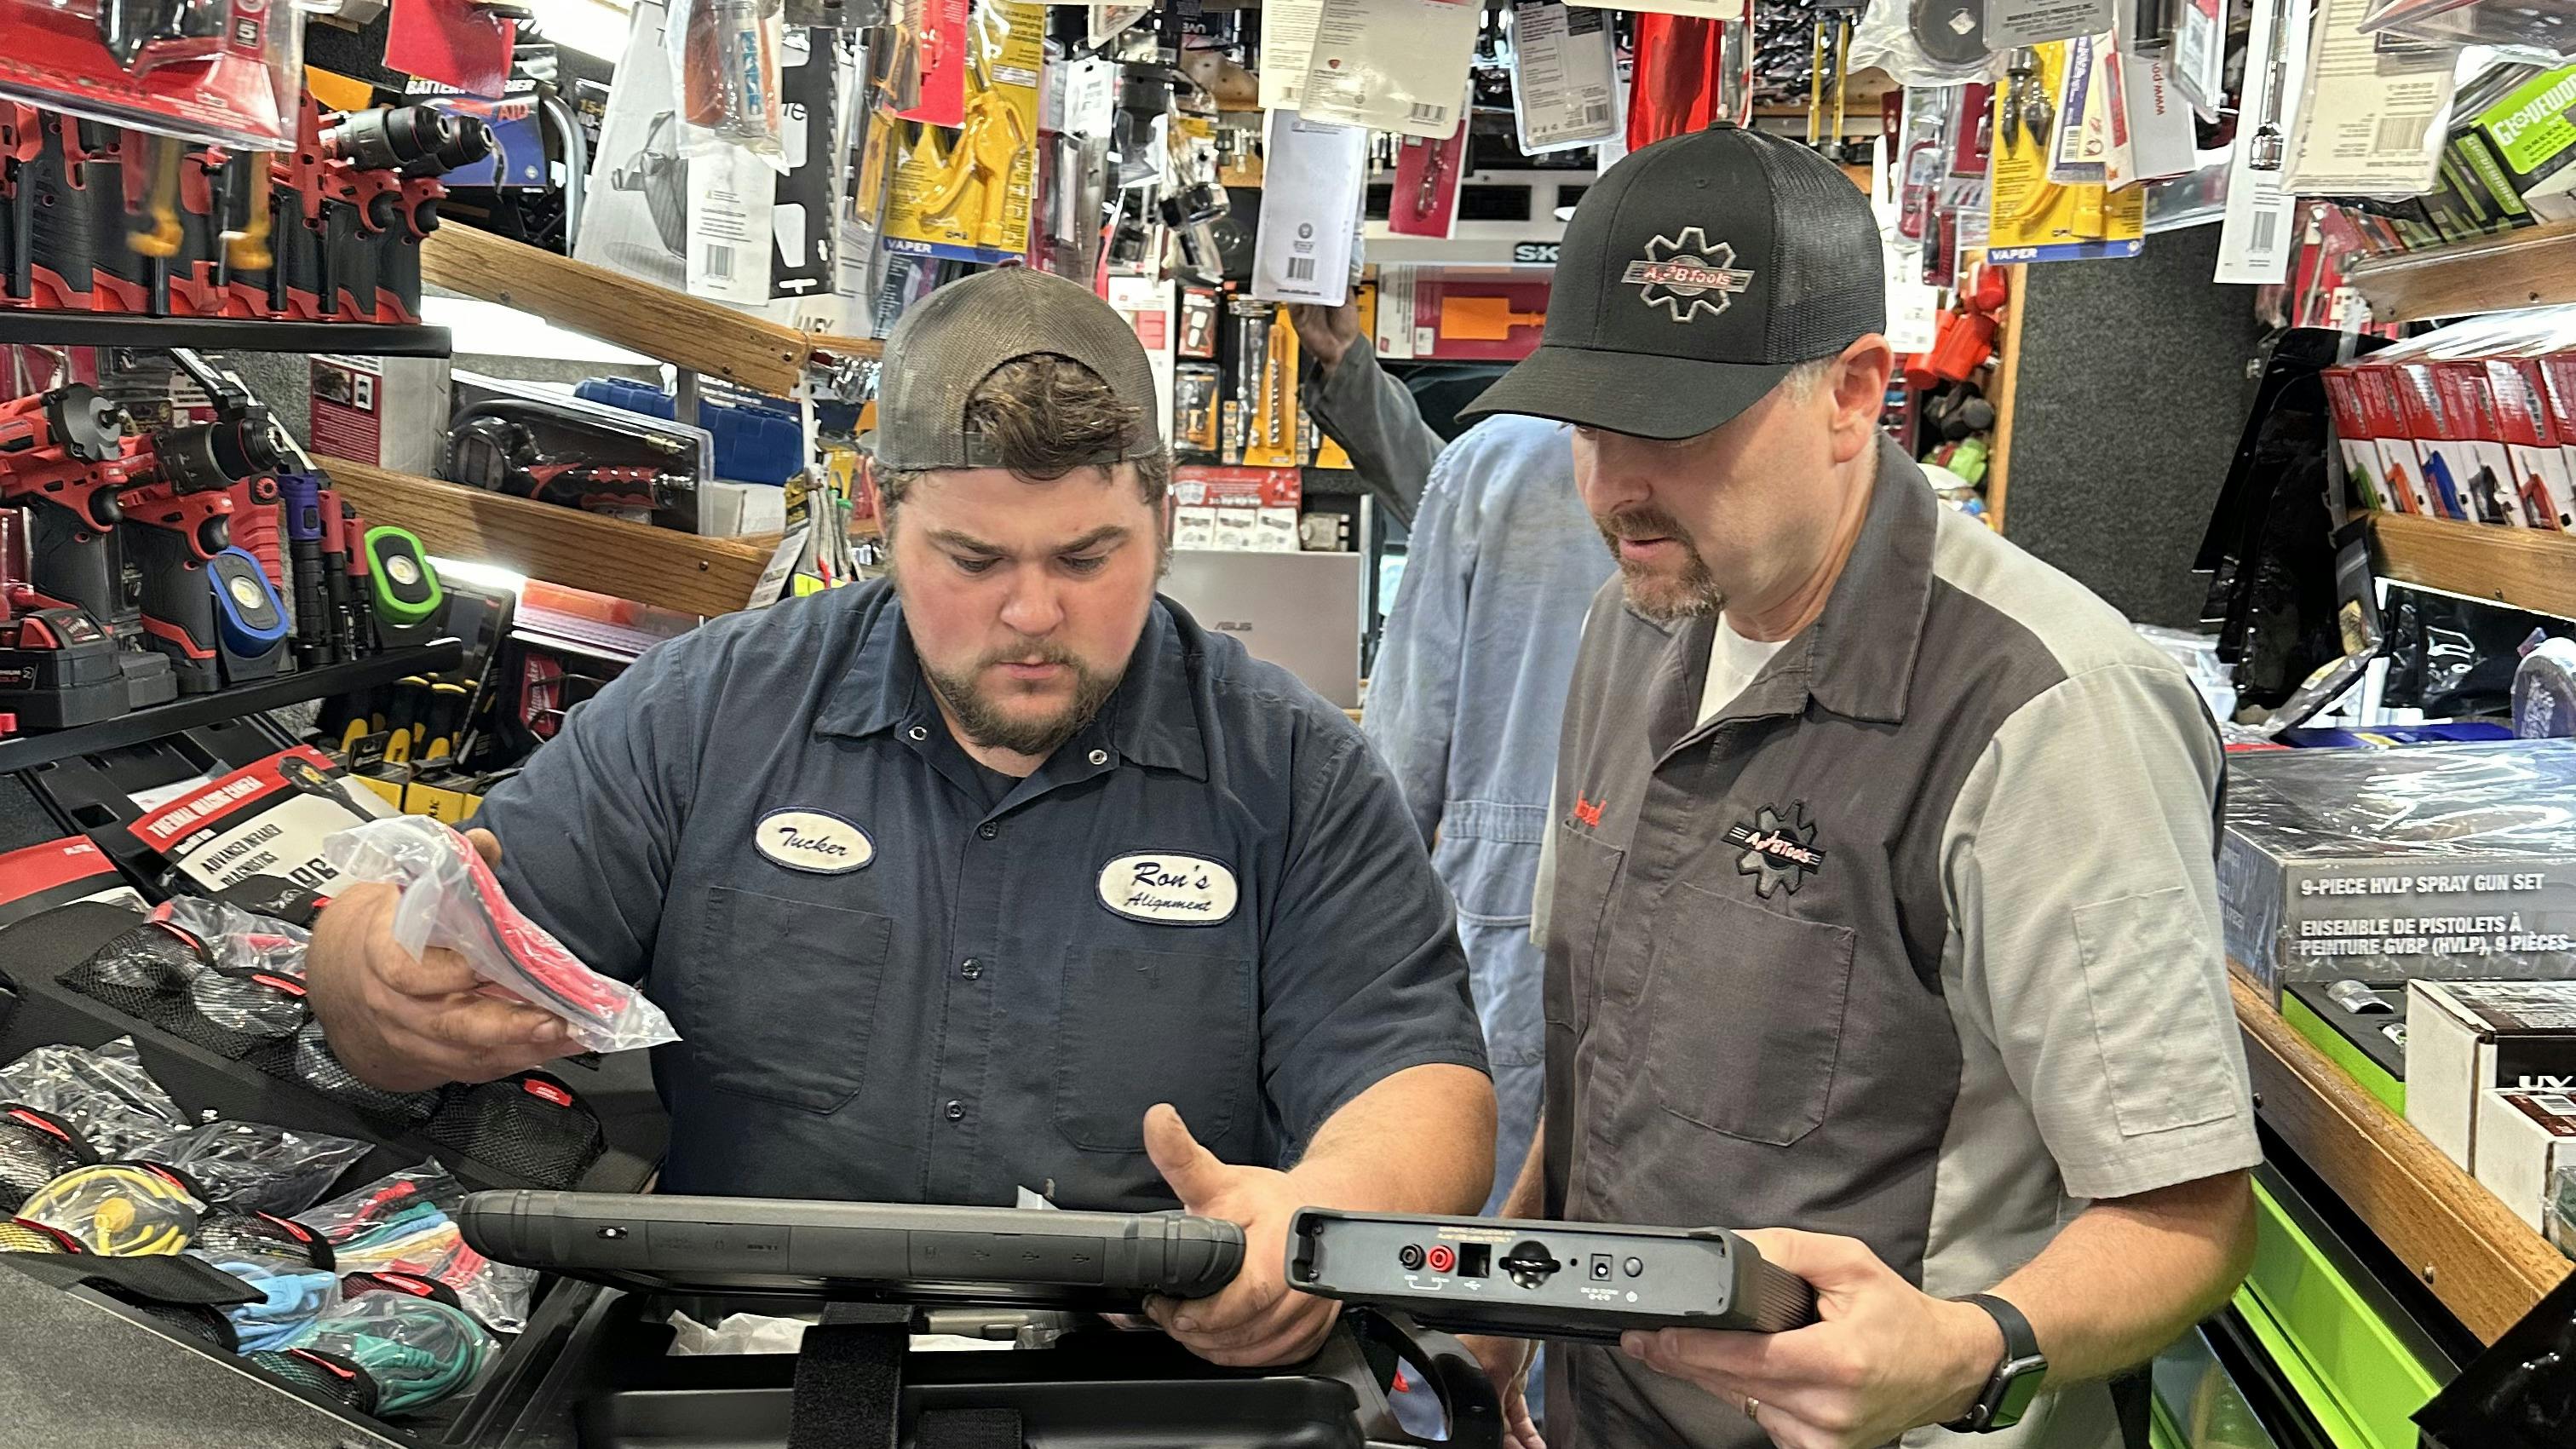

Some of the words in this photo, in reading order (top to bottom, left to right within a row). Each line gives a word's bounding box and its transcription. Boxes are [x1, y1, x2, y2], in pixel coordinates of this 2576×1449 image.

[887, 239, 933, 255] VAPER
[1992, 248, 2038, 262] VAPER
[1215, 621, 1252, 631] ASUS
[778, 826, 849, 858] Tucker
[201, 840, 251, 876] ADVANCED
[1131, 860, 1212, 890] Ron's
[2301, 878, 2367, 895] 9-PIECE
[2370, 877, 2413, 894] HVLP
[2416, 876, 2471, 893] SPRAY
[2474, 874, 2510, 892] GUN
[2512, 873, 2545, 891] SET
[1124, 891, 1212, 912] Alignment
[2301, 918, 2389, 937] ENSEMBLE
[2393, 918, 2417, 935] DE
[2418, 916, 2507, 934] PISTOLETS
[2509, 911, 2523, 933] À
[2300, 937, 2380, 956] PEINTURE
[2384, 937, 2429, 956] GVBP
[2495, 935, 2509, 951] 9
[2510, 930, 2569, 952] PIÈCES
